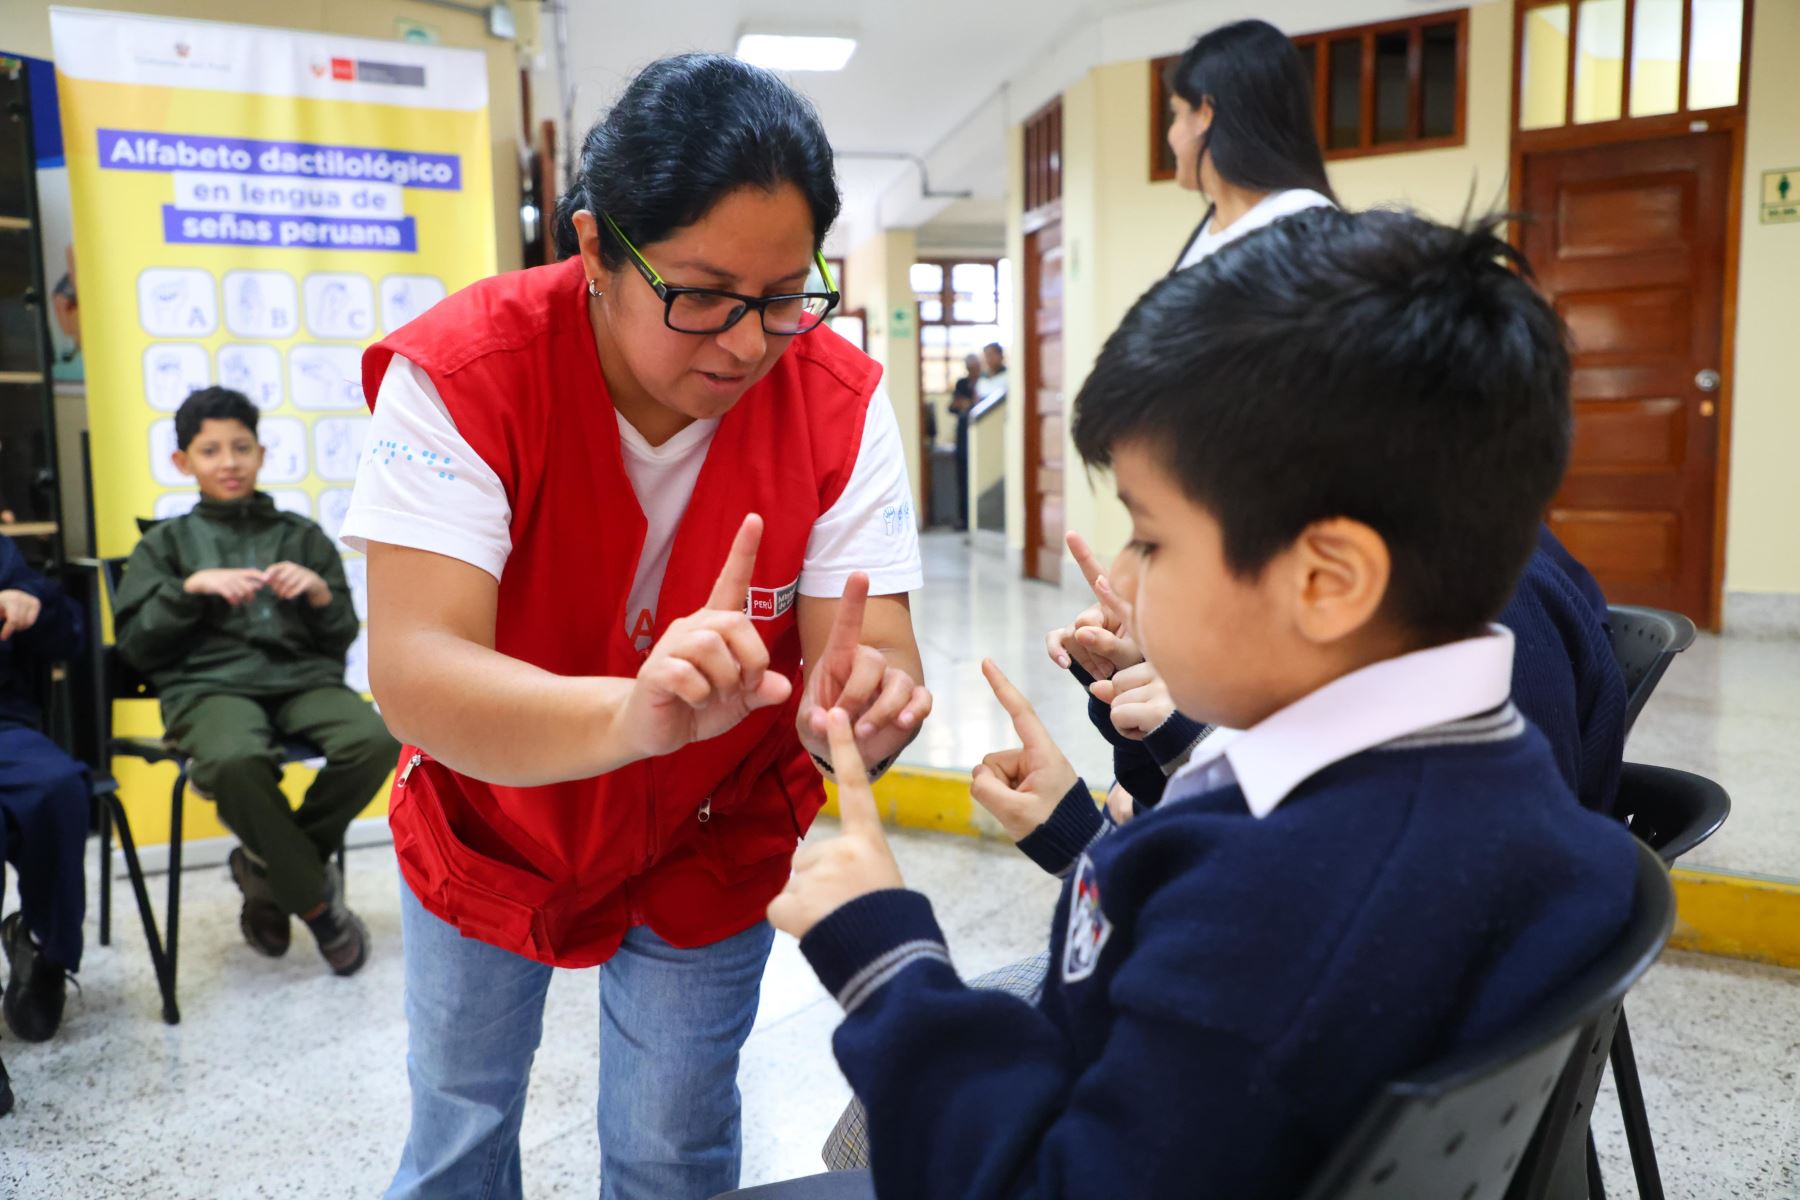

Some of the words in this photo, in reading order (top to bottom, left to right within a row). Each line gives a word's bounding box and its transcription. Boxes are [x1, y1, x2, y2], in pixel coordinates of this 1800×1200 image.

[110, 137, 252, 171] Alfabeto
[259, 146, 453, 184] dactilológico
[193, 183, 230, 202] en
[240, 181, 341, 209] lengua
[352, 187, 387, 210] de
[182, 213, 273, 241] señas
[279, 220, 401, 246] peruana
[187, 307, 207, 328] A
[271, 308, 289, 329] B
[347, 310, 366, 331] C
[753, 599, 773, 610] PERÚ
